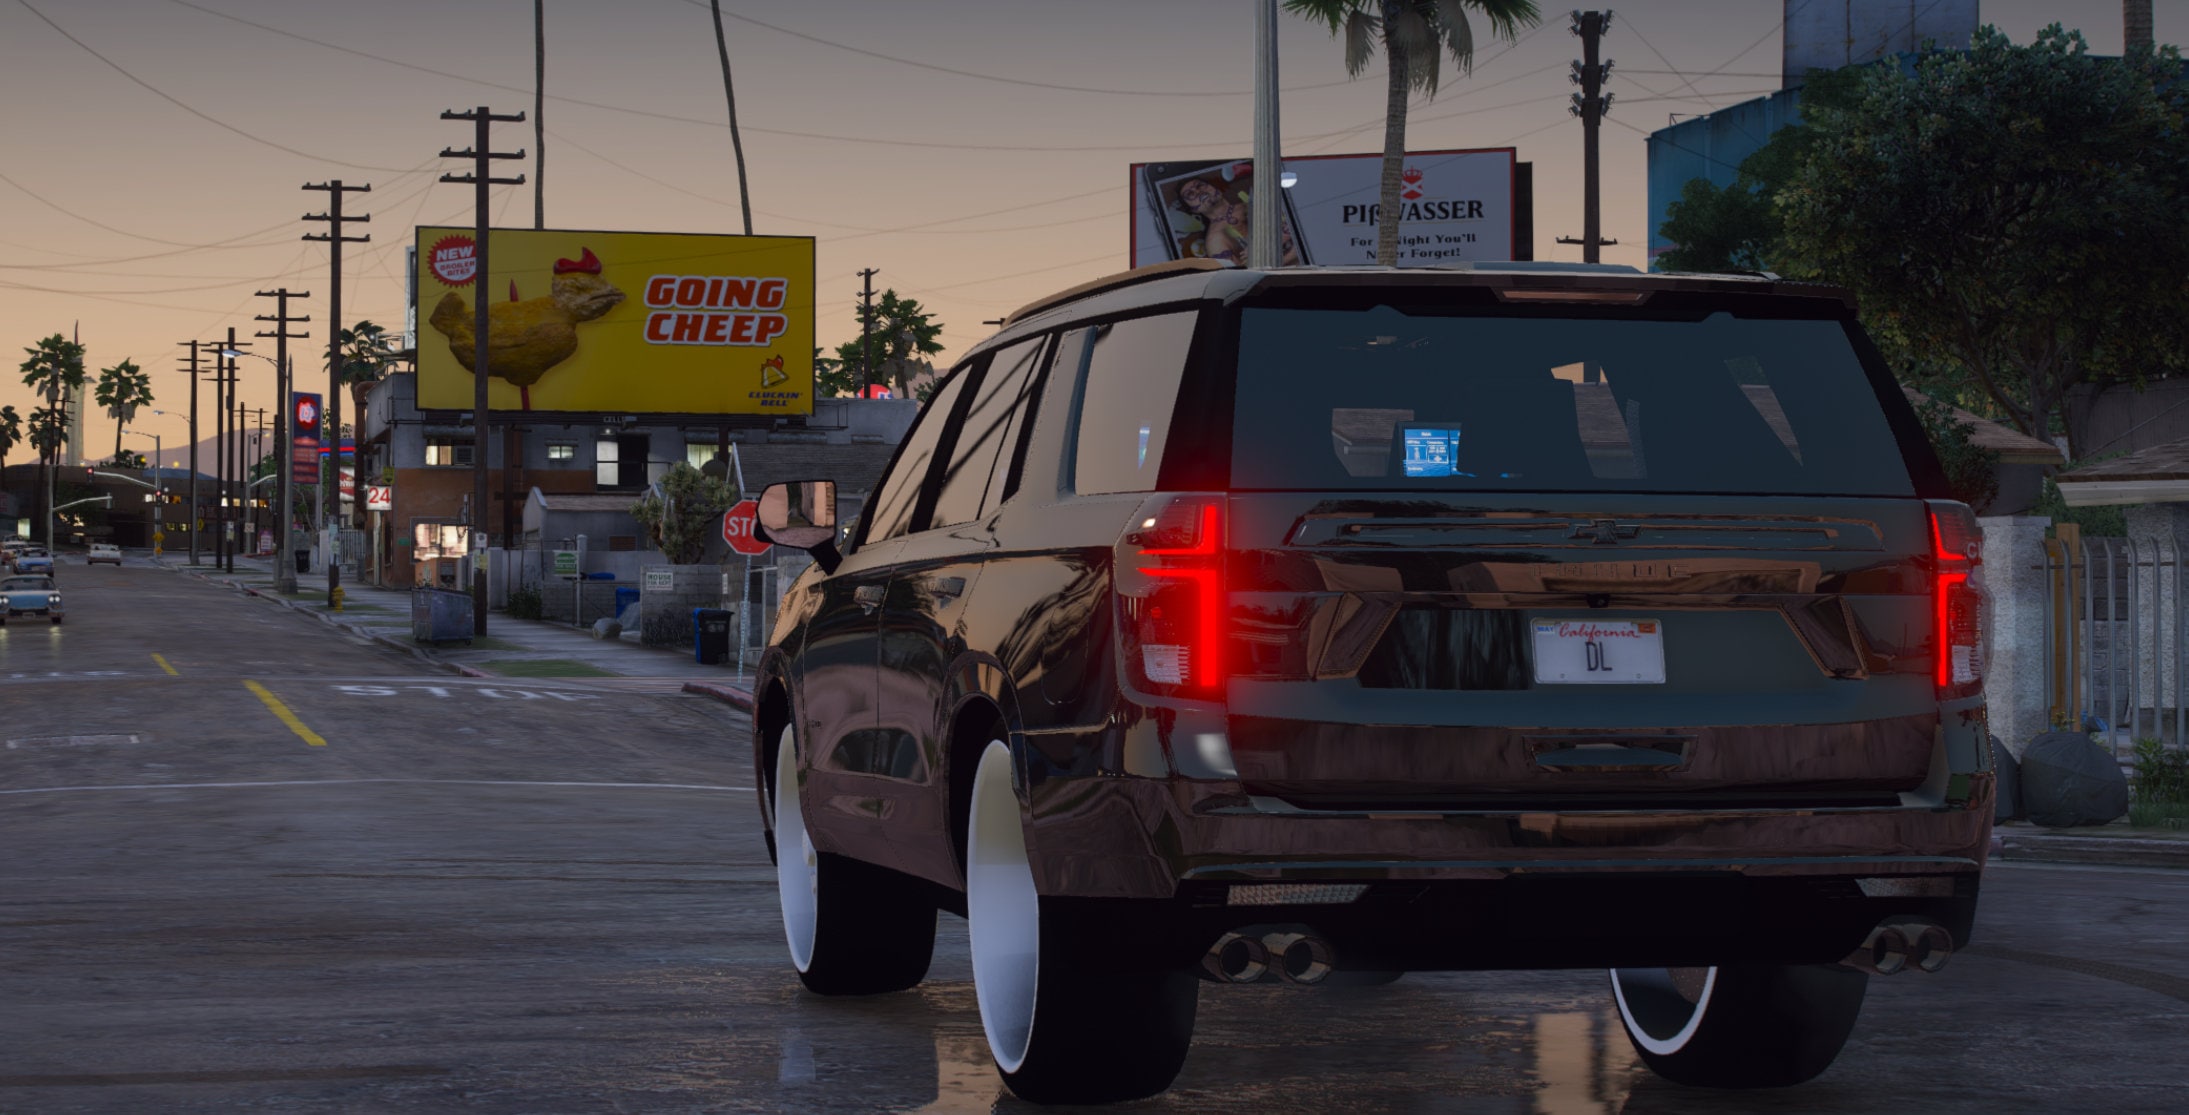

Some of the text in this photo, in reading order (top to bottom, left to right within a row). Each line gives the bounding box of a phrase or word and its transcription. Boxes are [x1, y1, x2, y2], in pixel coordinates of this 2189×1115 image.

[1342, 200, 1484, 226] PIßASSER
[1350, 237, 1373, 247] For
[1435, 233, 1476, 244] You'll
[437, 245, 474, 261] NEW
[1411, 248, 1460, 259] Forget!
[447, 268, 470, 276] BITES
[645, 276, 787, 310] GOING
[645, 311, 788, 346] CHEEP
[760, 399, 788, 407] BELL
[368, 487, 391, 504] 24
[727, 516, 757, 537] ST
[1559, 623, 1641, 642] California
[1585, 641, 1613, 671] DL
[334, 685, 601, 701] STOP
